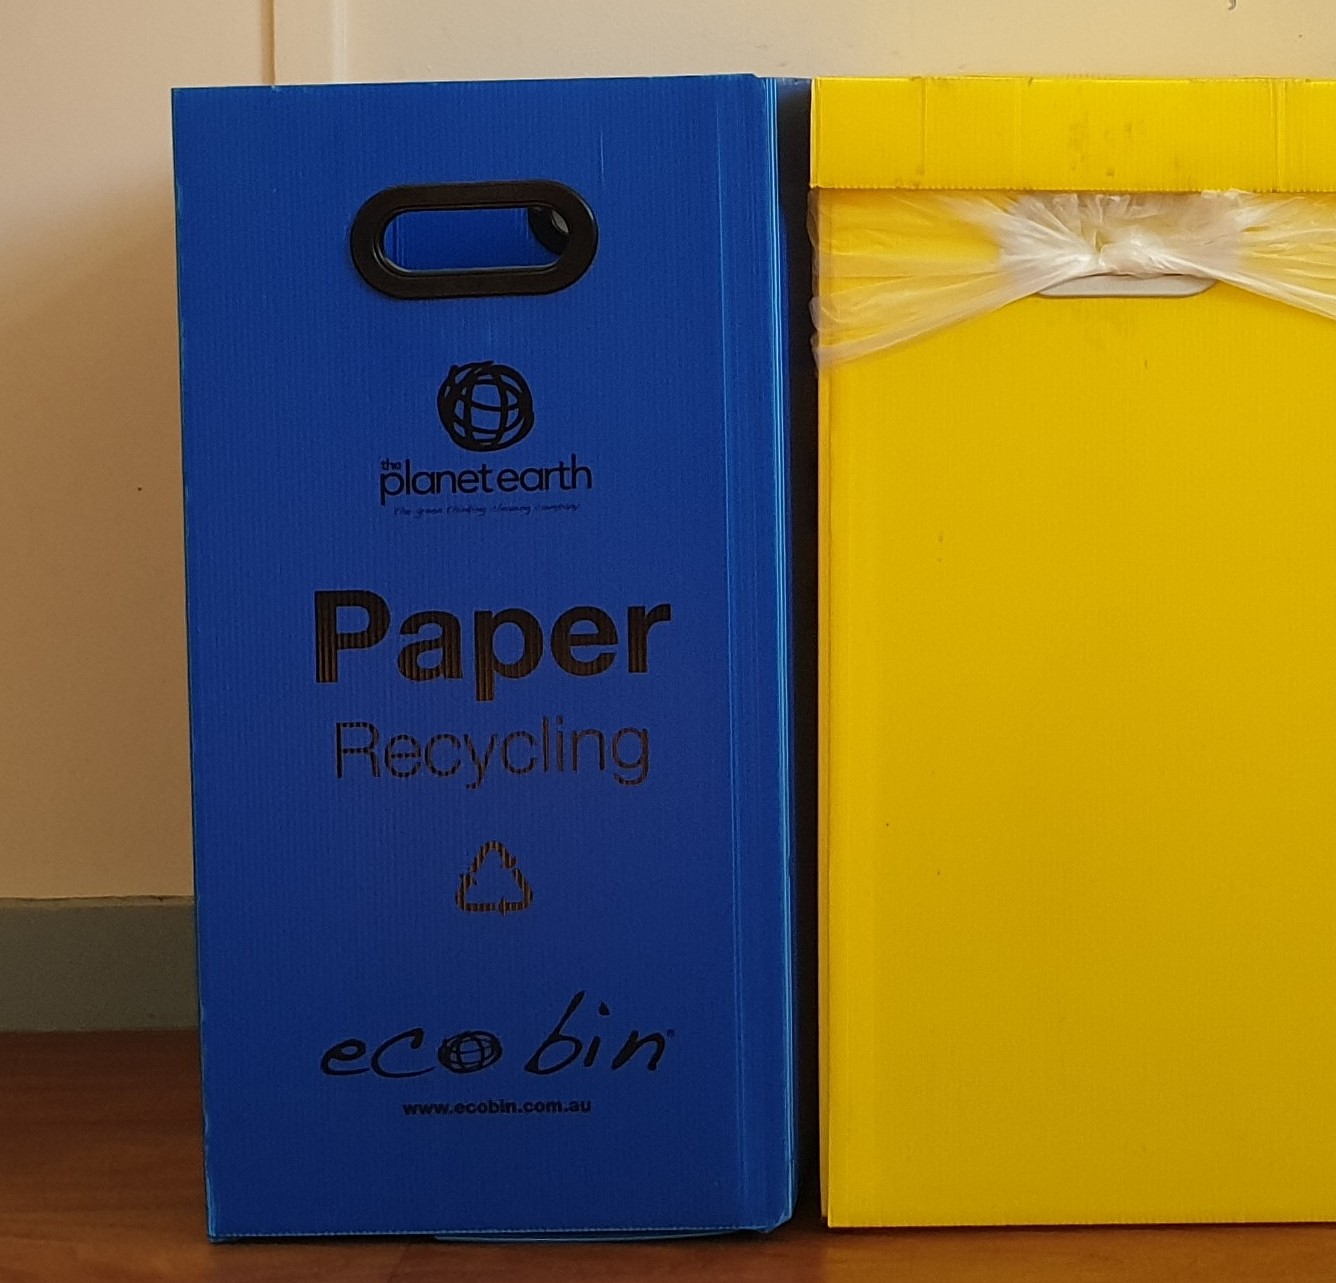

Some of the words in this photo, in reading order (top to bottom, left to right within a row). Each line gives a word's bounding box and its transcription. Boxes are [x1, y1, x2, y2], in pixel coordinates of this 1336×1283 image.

[379, 458, 493, 506] planet
[496, 453, 593, 493] earth
[380, 458, 402, 471] the
[313, 589, 672, 702] Paper
[334, 714, 652, 790] Recycling
[319, 1027, 504, 1079] eco
[523, 990, 668, 1077] bin
[402, 1099, 592, 1116] www.ecobin.com.au
